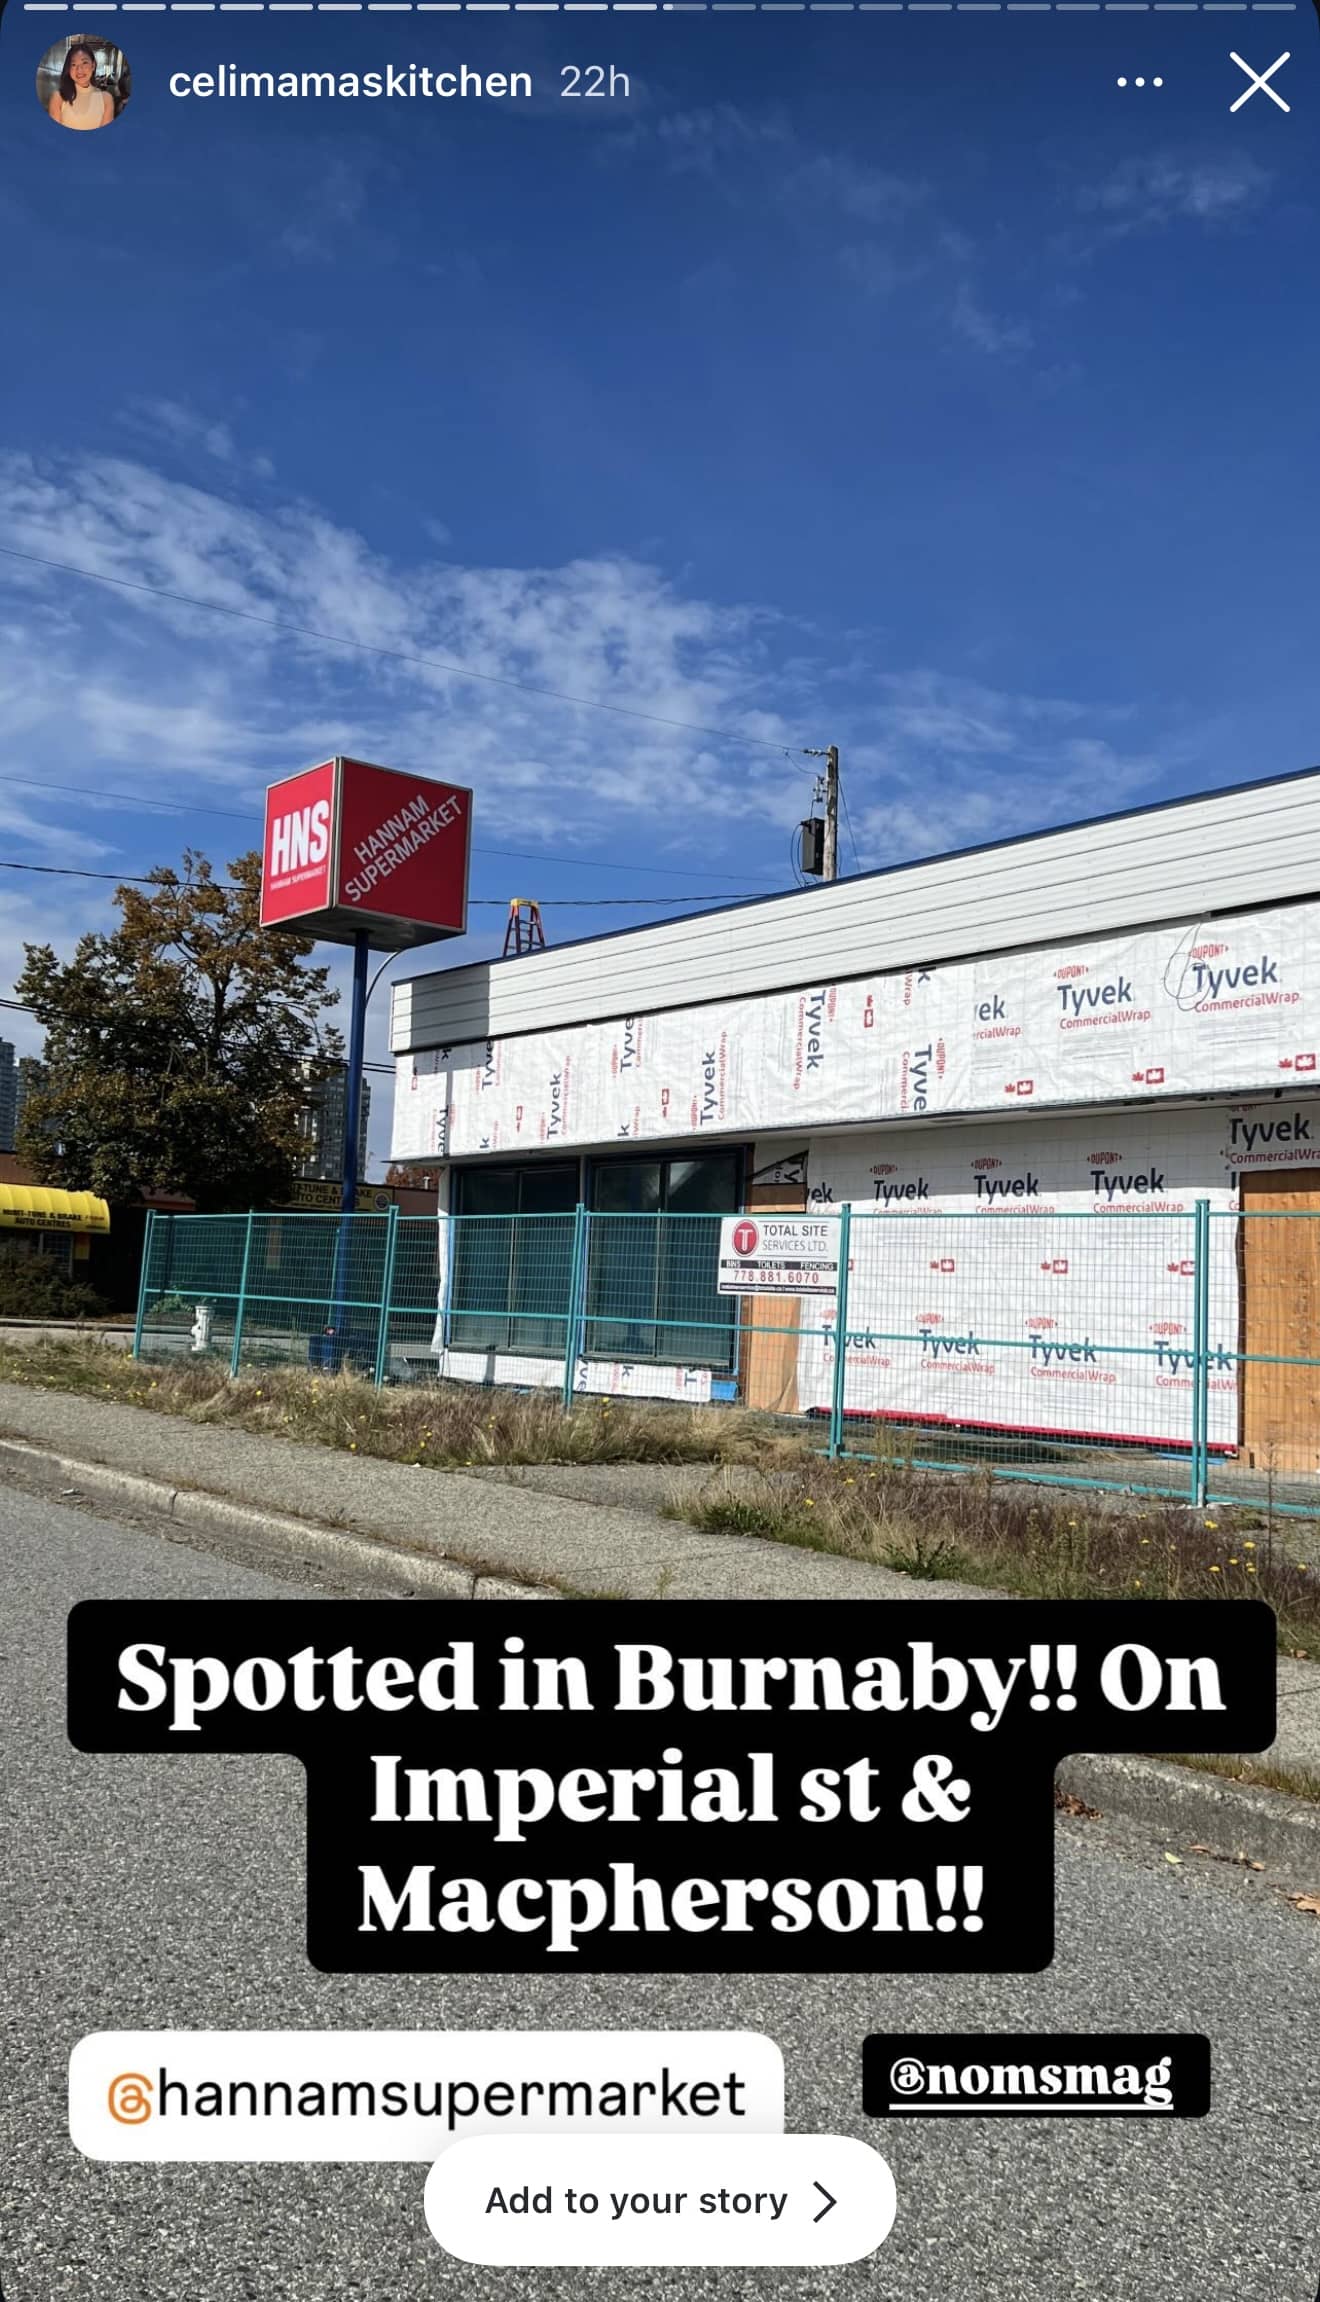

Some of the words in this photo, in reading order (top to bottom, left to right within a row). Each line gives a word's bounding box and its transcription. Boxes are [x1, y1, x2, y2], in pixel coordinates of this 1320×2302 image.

[271, 800, 329, 876] HNS
[354, 795, 430, 864] HANNAM
[345, 795, 462, 902] SUPERMARKET
[1191, 944, 1224, 959] DUPONT
[1057, 965, 1086, 980] DUPONT
[1192, 955, 1278, 999] Tyvek
[1057, 976, 1133, 1017] Tyvek
[1194, 991, 1300, 1013] CommercialWrap
[805, 989, 827, 1070] Tyvek
[975, 1025, 1021, 1040] rcialWrap
[1060, 1009, 1151, 1030] CommercialWrap
[620, 1016, 636, 1072] Tyve
[793, 996, 806, 1090] CommercialWrap
[700, 1050, 718, 1126] Tyvek
[718, 1031, 728, 1120] CommercialWrap
[900, 1051, 911, 1112] Commerci
[909, 1043, 932, 1111] Tyve
[547, 1072, 561, 1139] Tyvek
[1230, 1112, 1311, 1152] Tyvek
[974, 1157, 999, 1170] DUPONT
[1090, 1151, 1119, 1165] DUPONT
[1230, 1147, 1320, 1164] CommercialWra
[874, 1178, 930, 1208] Tyvek
[973, 1172, 1040, 1206] Tyvek
[1090, 1168, 1165, 1202] Tyvek
[1094, 1201, 1184, 1214] CommercialWrap
[762, 1239, 806, 1252] SERVICES
[763, 1224, 798, 1237] TOTAL
[801, 1225, 829, 1237] SITE
[733, 1270, 820, 1284] 778.881.6070
[800, 1262, 834, 1272] FENCING
[919, 1328, 980, 1359] Tyvek
[1029, 1334, 1096, 1367] Tyvek
[1030, 1366, 1117, 1384] CommercialWrap
